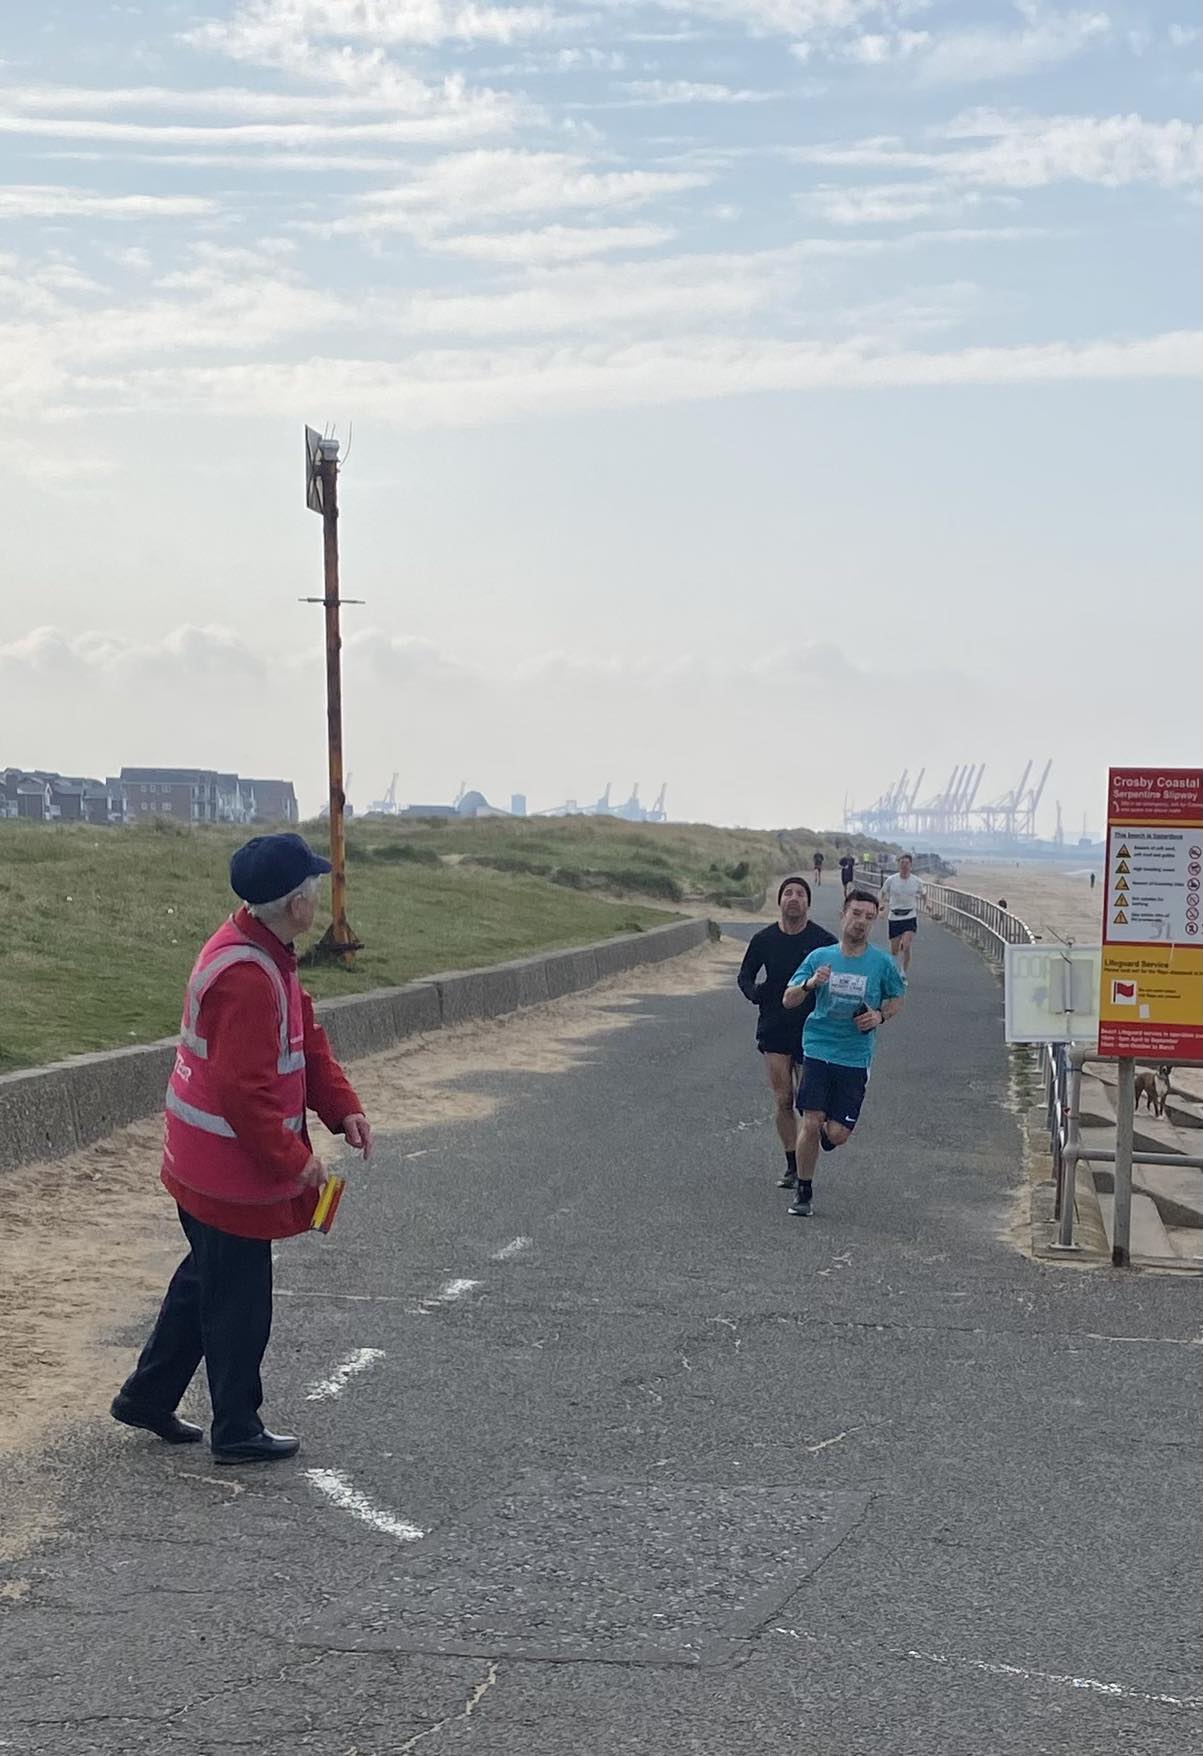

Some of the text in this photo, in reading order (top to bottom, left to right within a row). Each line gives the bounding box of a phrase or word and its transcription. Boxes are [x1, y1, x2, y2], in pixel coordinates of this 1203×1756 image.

[1113, 776, 1200, 789] Crosby Coastal
[1113, 789, 1199, 802] Serpentine Slipway
[1104, 959, 1169, 969] Lifeguard Service
